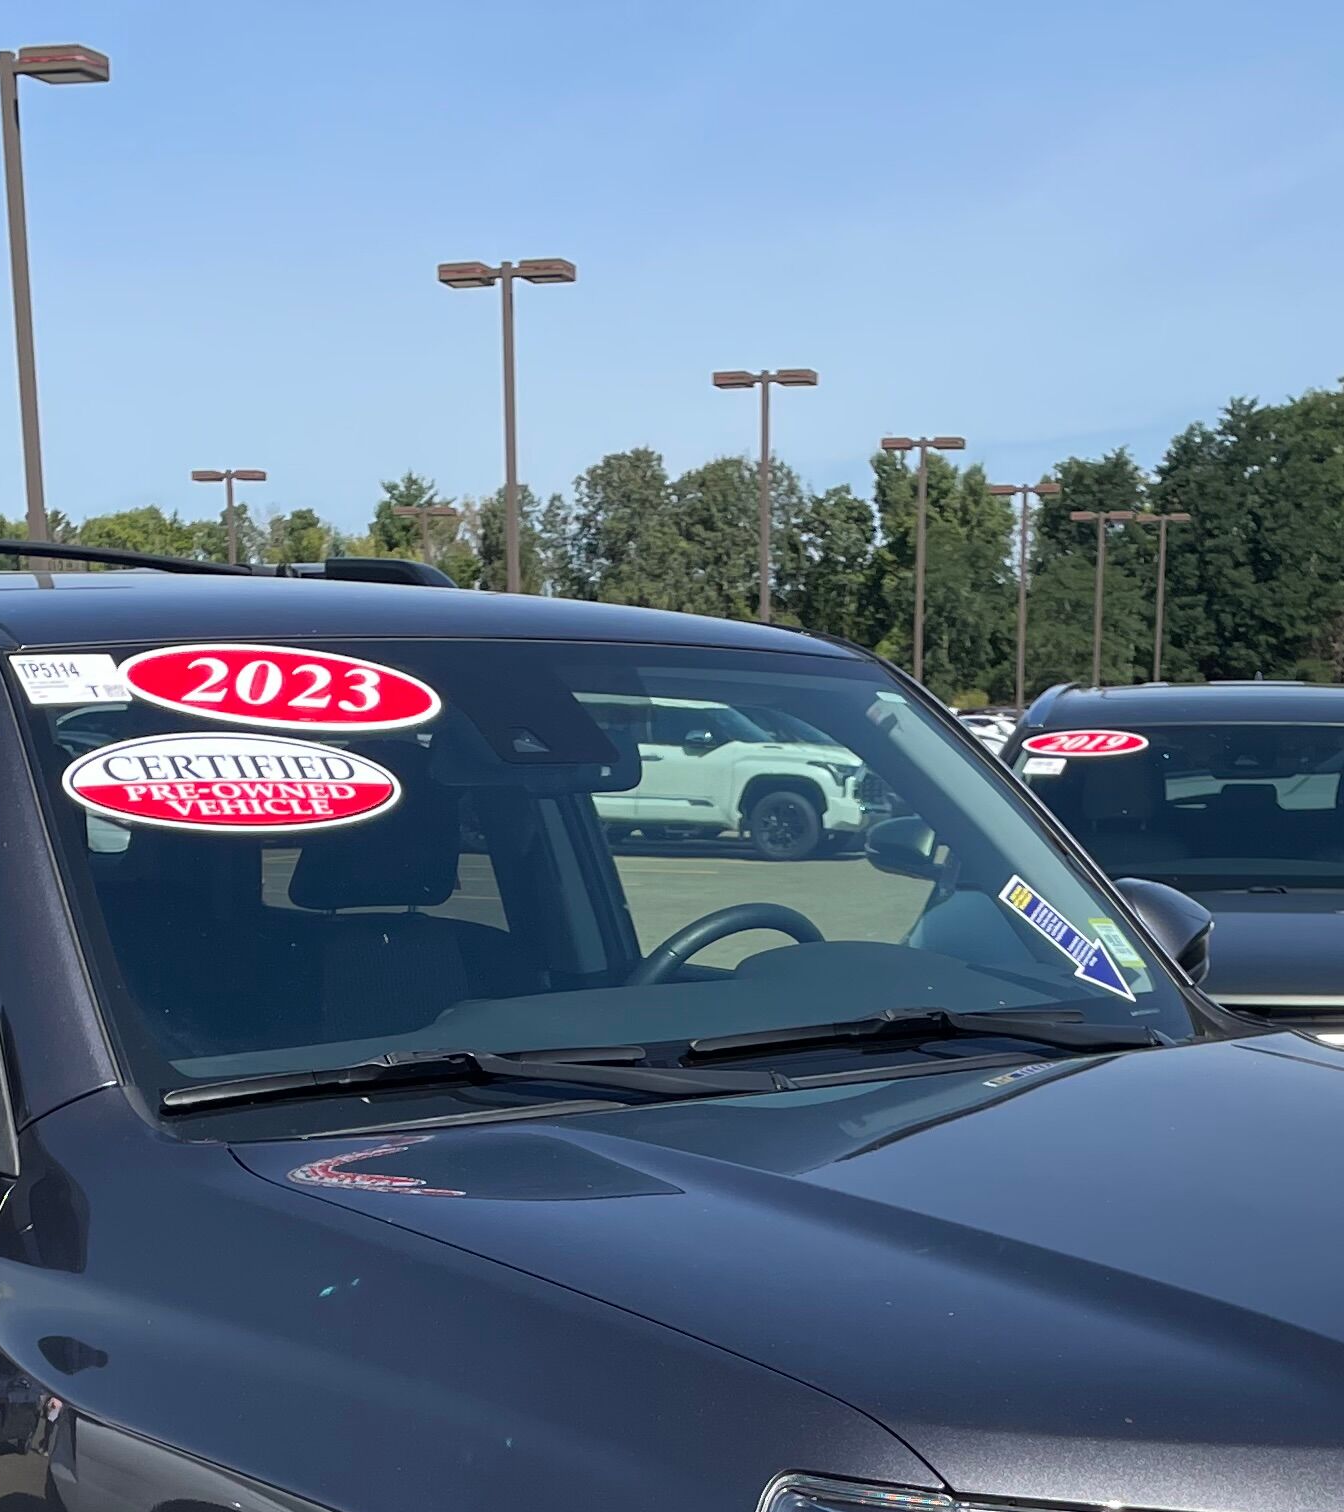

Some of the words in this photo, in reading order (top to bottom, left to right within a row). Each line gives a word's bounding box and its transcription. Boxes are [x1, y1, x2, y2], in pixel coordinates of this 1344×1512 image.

[18, 662, 80, 679] TP5114
[181, 657, 381, 712] 2023
[1040, 735, 1130, 751] 2019
[102, 755, 355, 782] CERTIFIED
[123, 783, 357, 801] PRE-OWNED
[164, 798, 334, 816] VEHICLE
